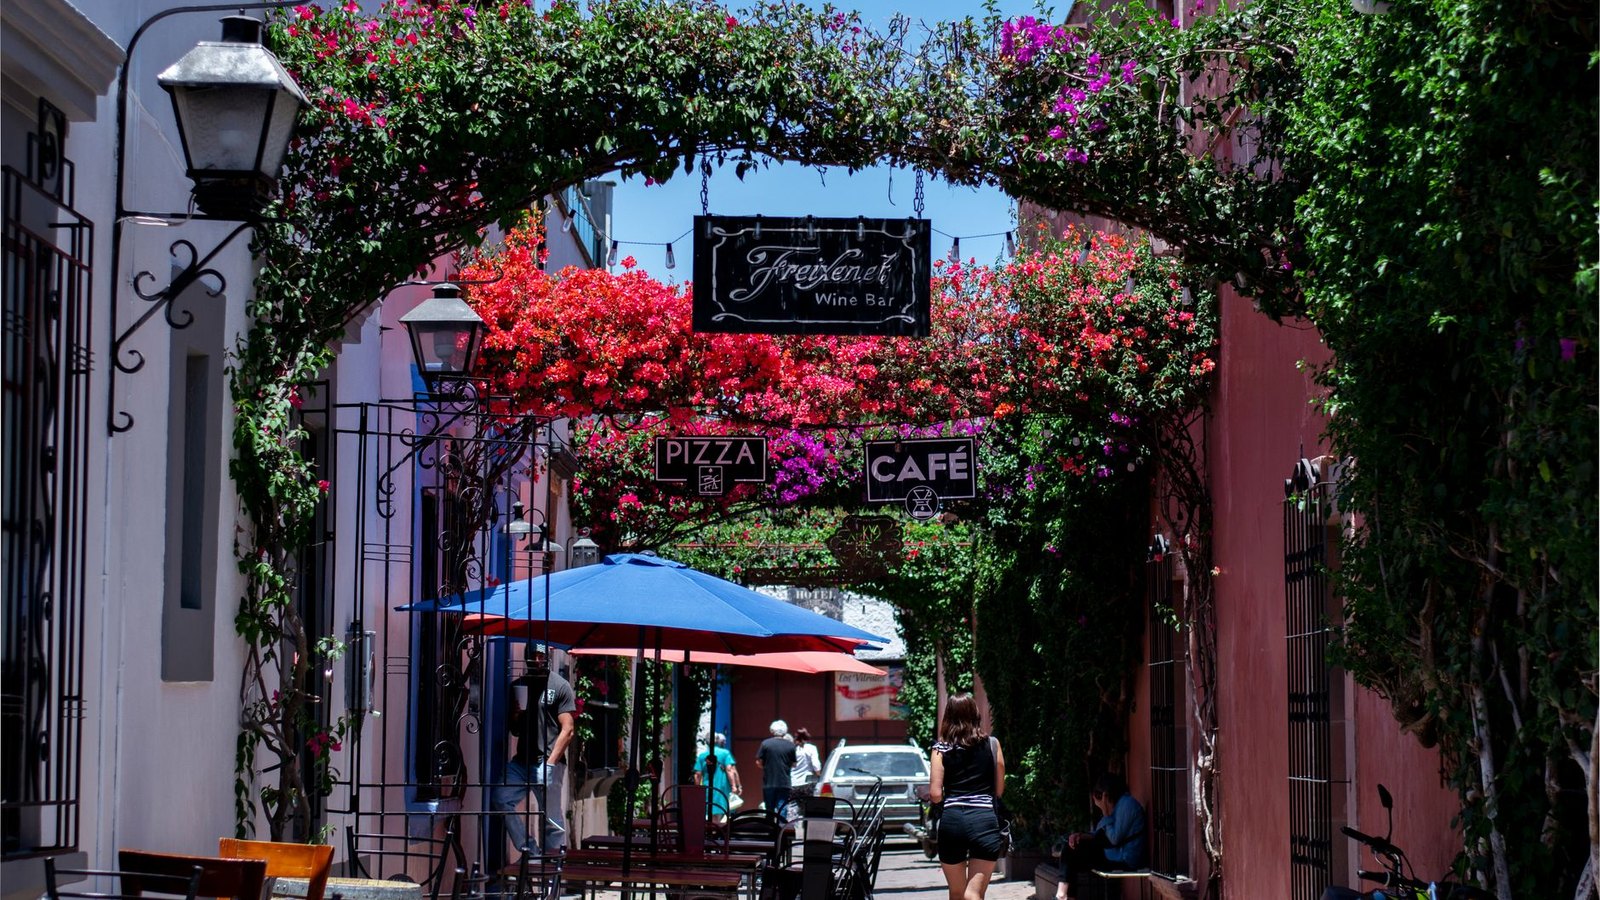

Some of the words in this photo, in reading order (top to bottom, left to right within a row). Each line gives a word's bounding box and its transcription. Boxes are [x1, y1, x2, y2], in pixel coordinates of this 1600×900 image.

[729, 245, 898, 301] Freixenet
[815, 292, 858, 307] Wine
[866, 293, 895, 307] Bar
[666, 440, 755, 465] PIZZA
[871, 445, 968, 483] CAFÉ
[796, 590, 836, 599] HOTEL
